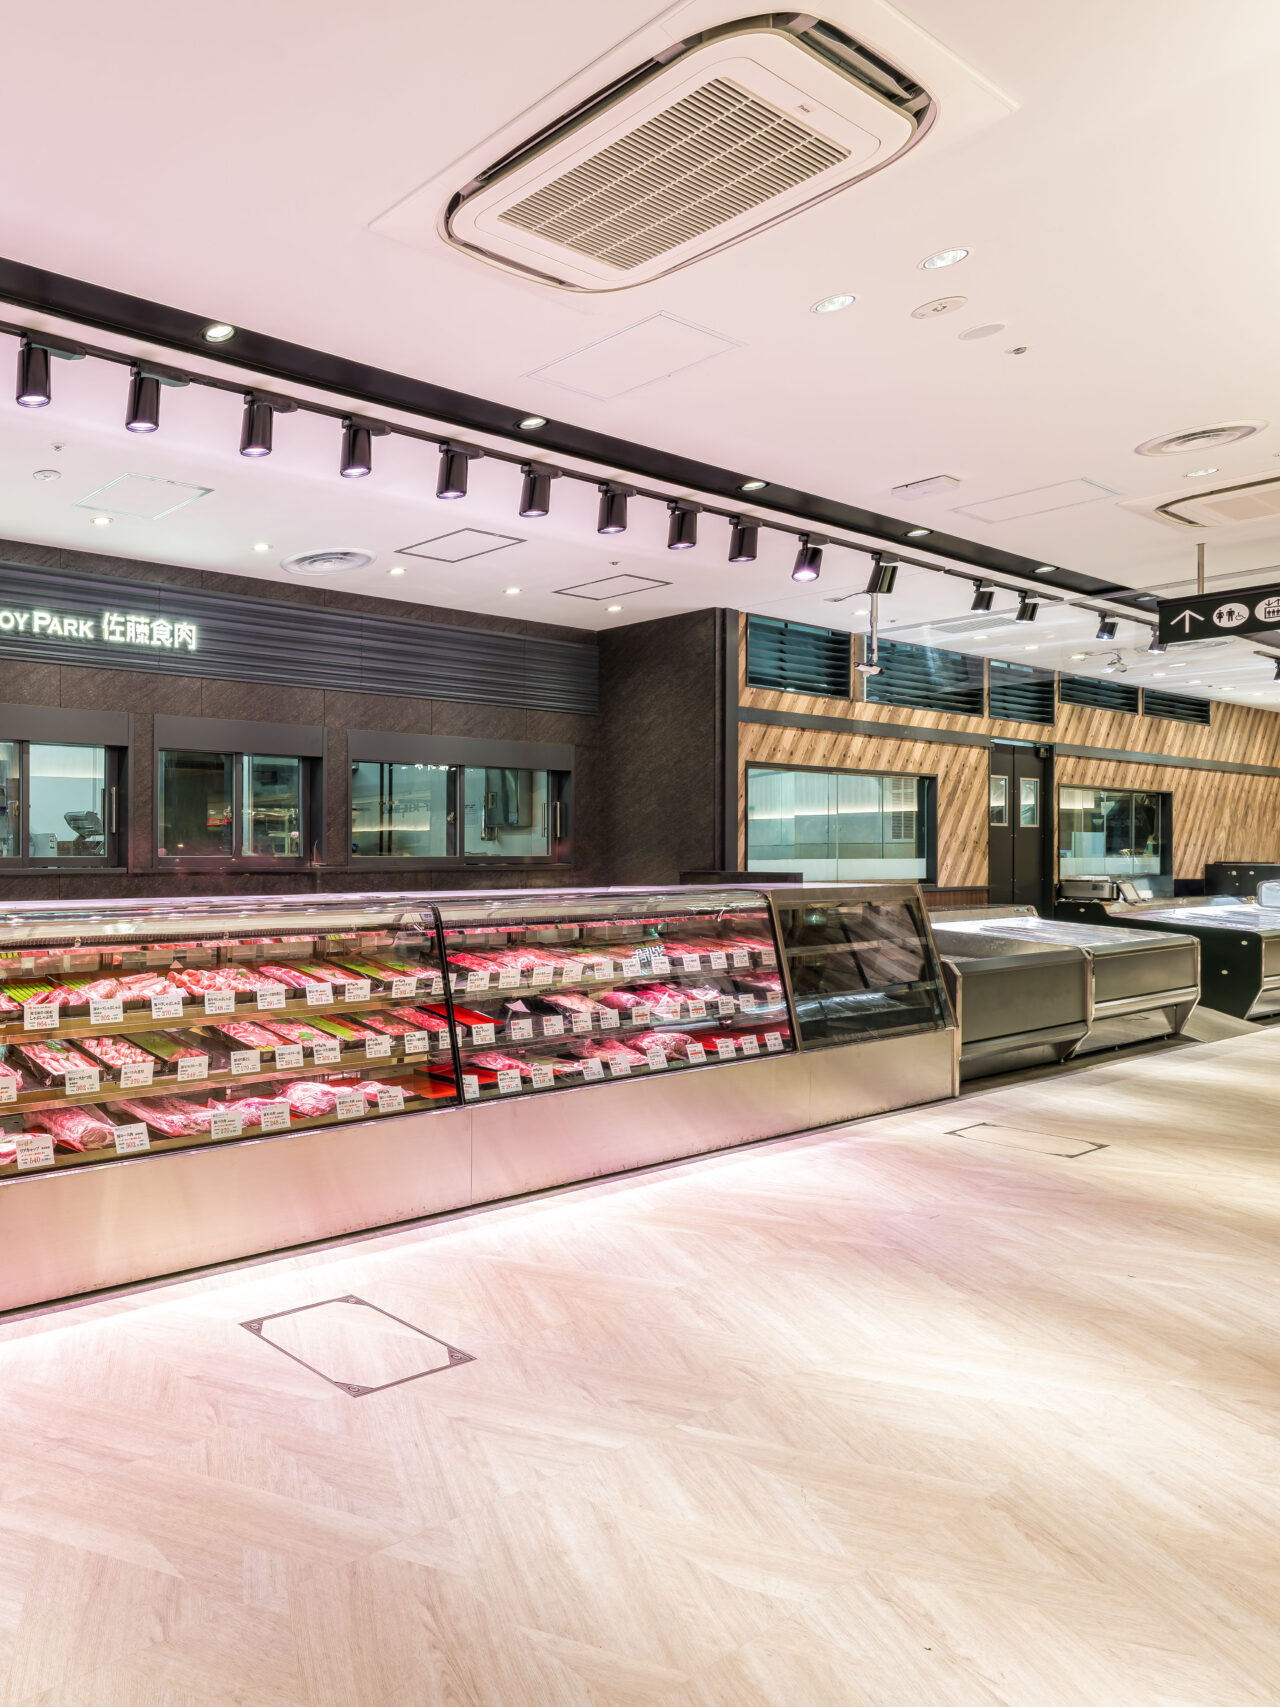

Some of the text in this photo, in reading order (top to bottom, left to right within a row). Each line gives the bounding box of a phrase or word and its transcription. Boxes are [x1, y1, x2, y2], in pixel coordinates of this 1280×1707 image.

[33, 611, 93, 639] PARK
[103, 612, 197, 651] 佐藤食肉
